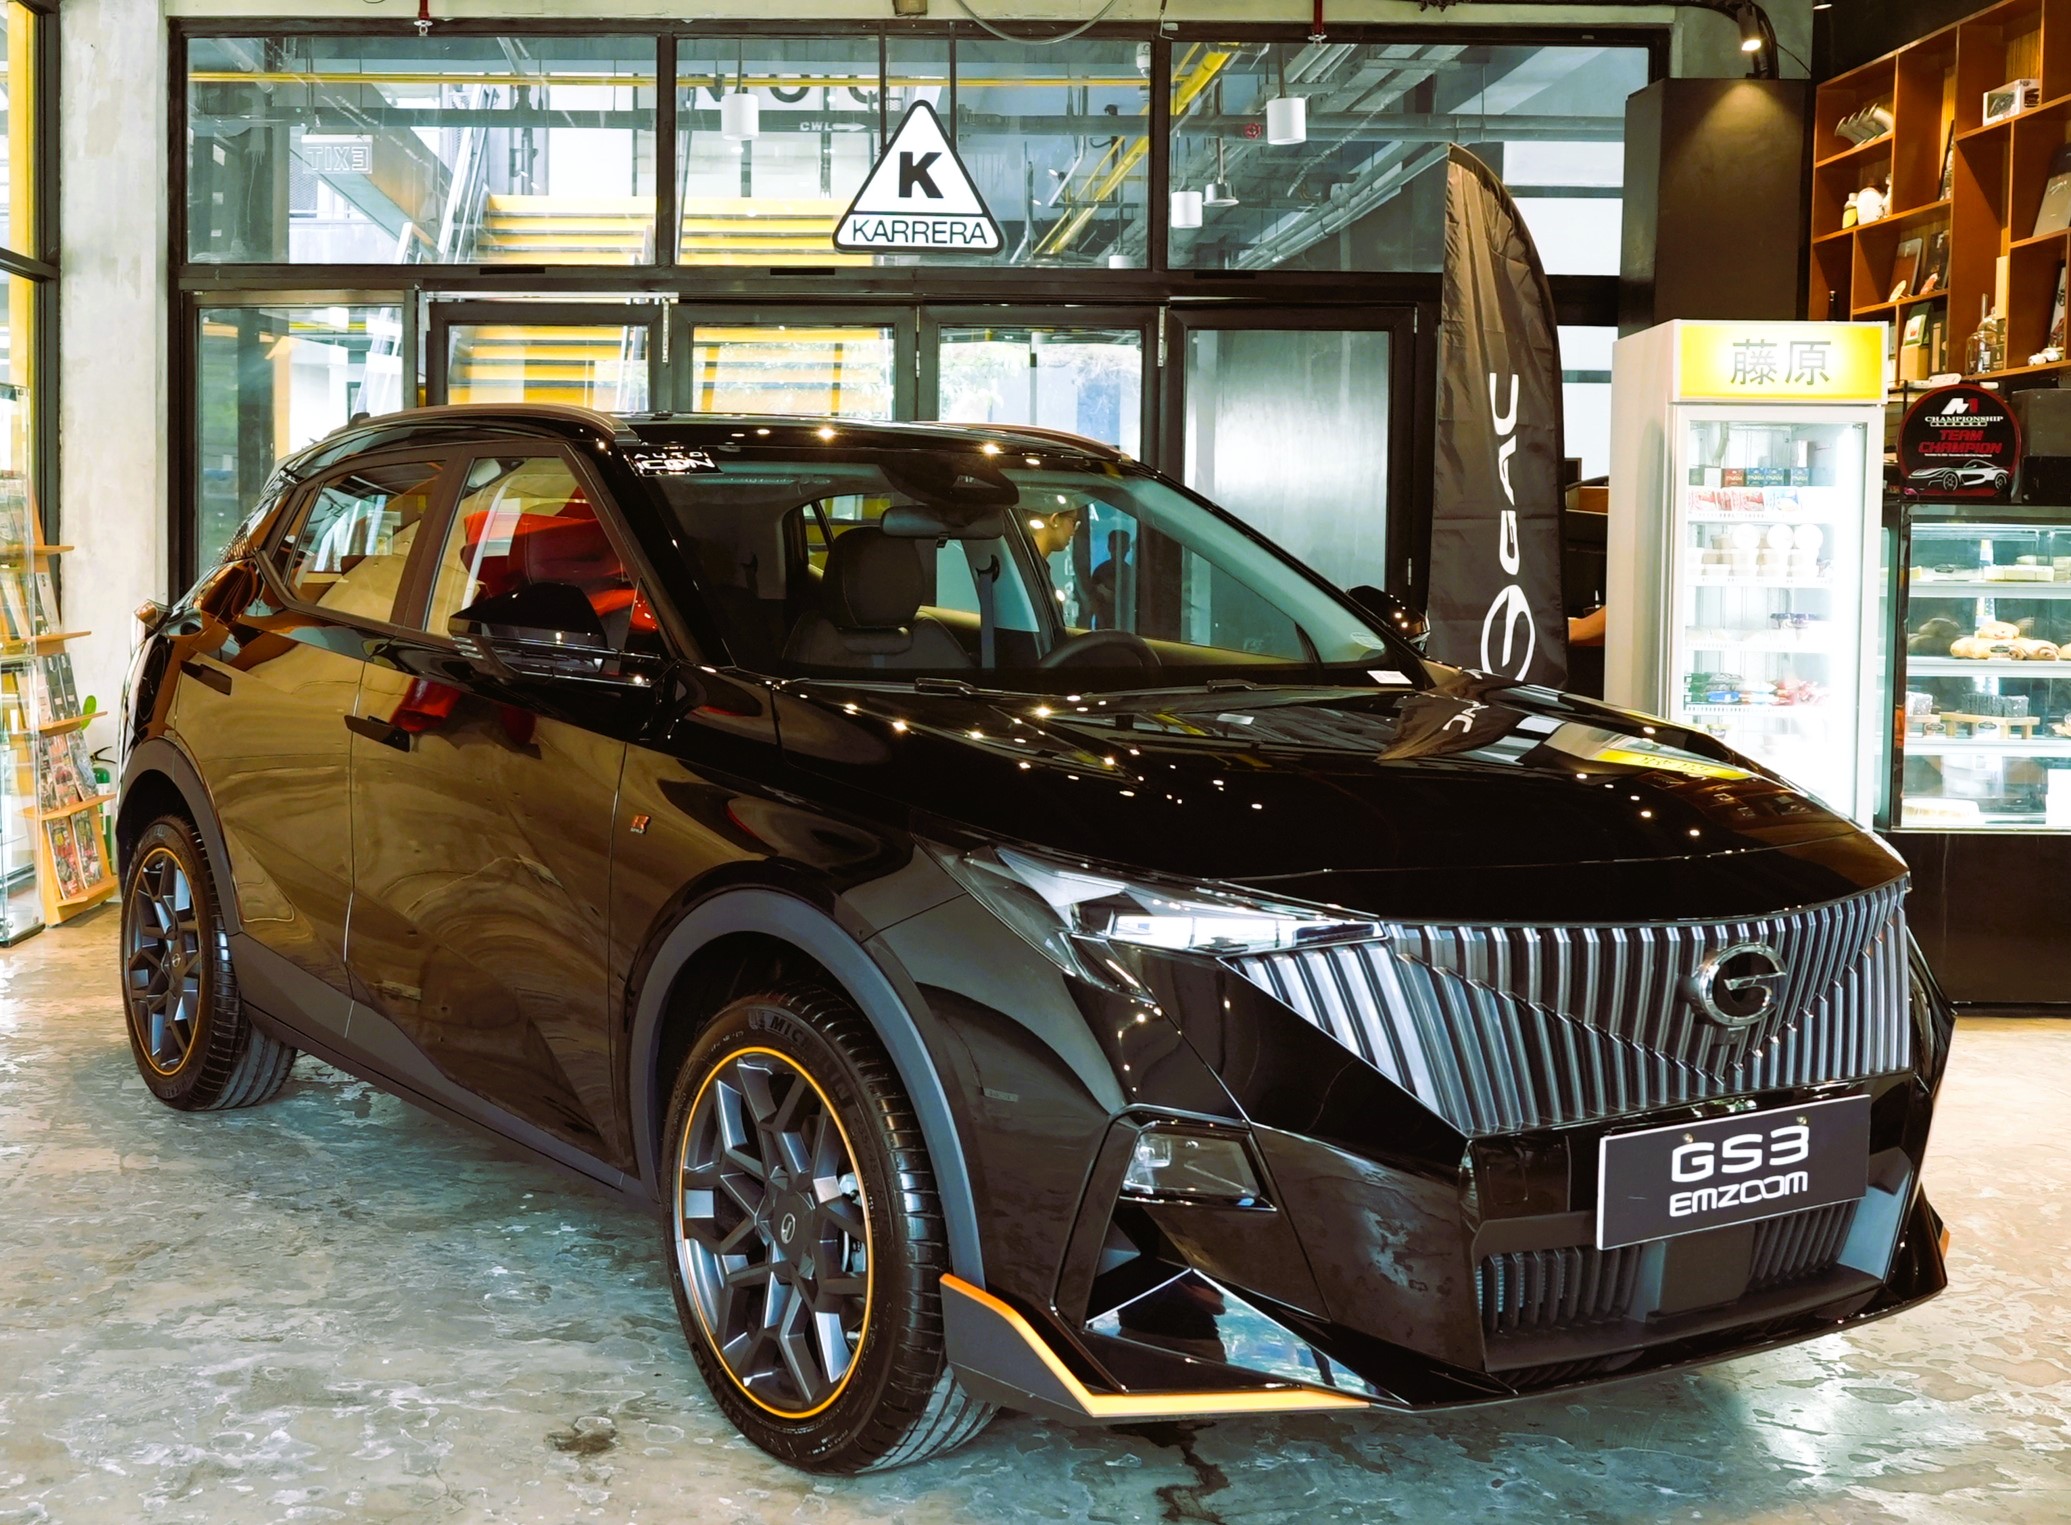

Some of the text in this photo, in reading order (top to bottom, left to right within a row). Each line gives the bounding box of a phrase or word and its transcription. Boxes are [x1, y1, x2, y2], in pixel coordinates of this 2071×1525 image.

[800, 122, 832, 132] CWL
[899, 151, 944, 199] K
[852, 219, 987, 245] KARRERA
[1730, 338, 1832, 386] 藤原
[1924, 415, 2004, 423] CHAMPIONSHIP
[1939, 429, 1985, 441] TEAM
[1917, 441, 2003, 454] CHAMPION
[1671, 1125, 1810, 1183] GS3
